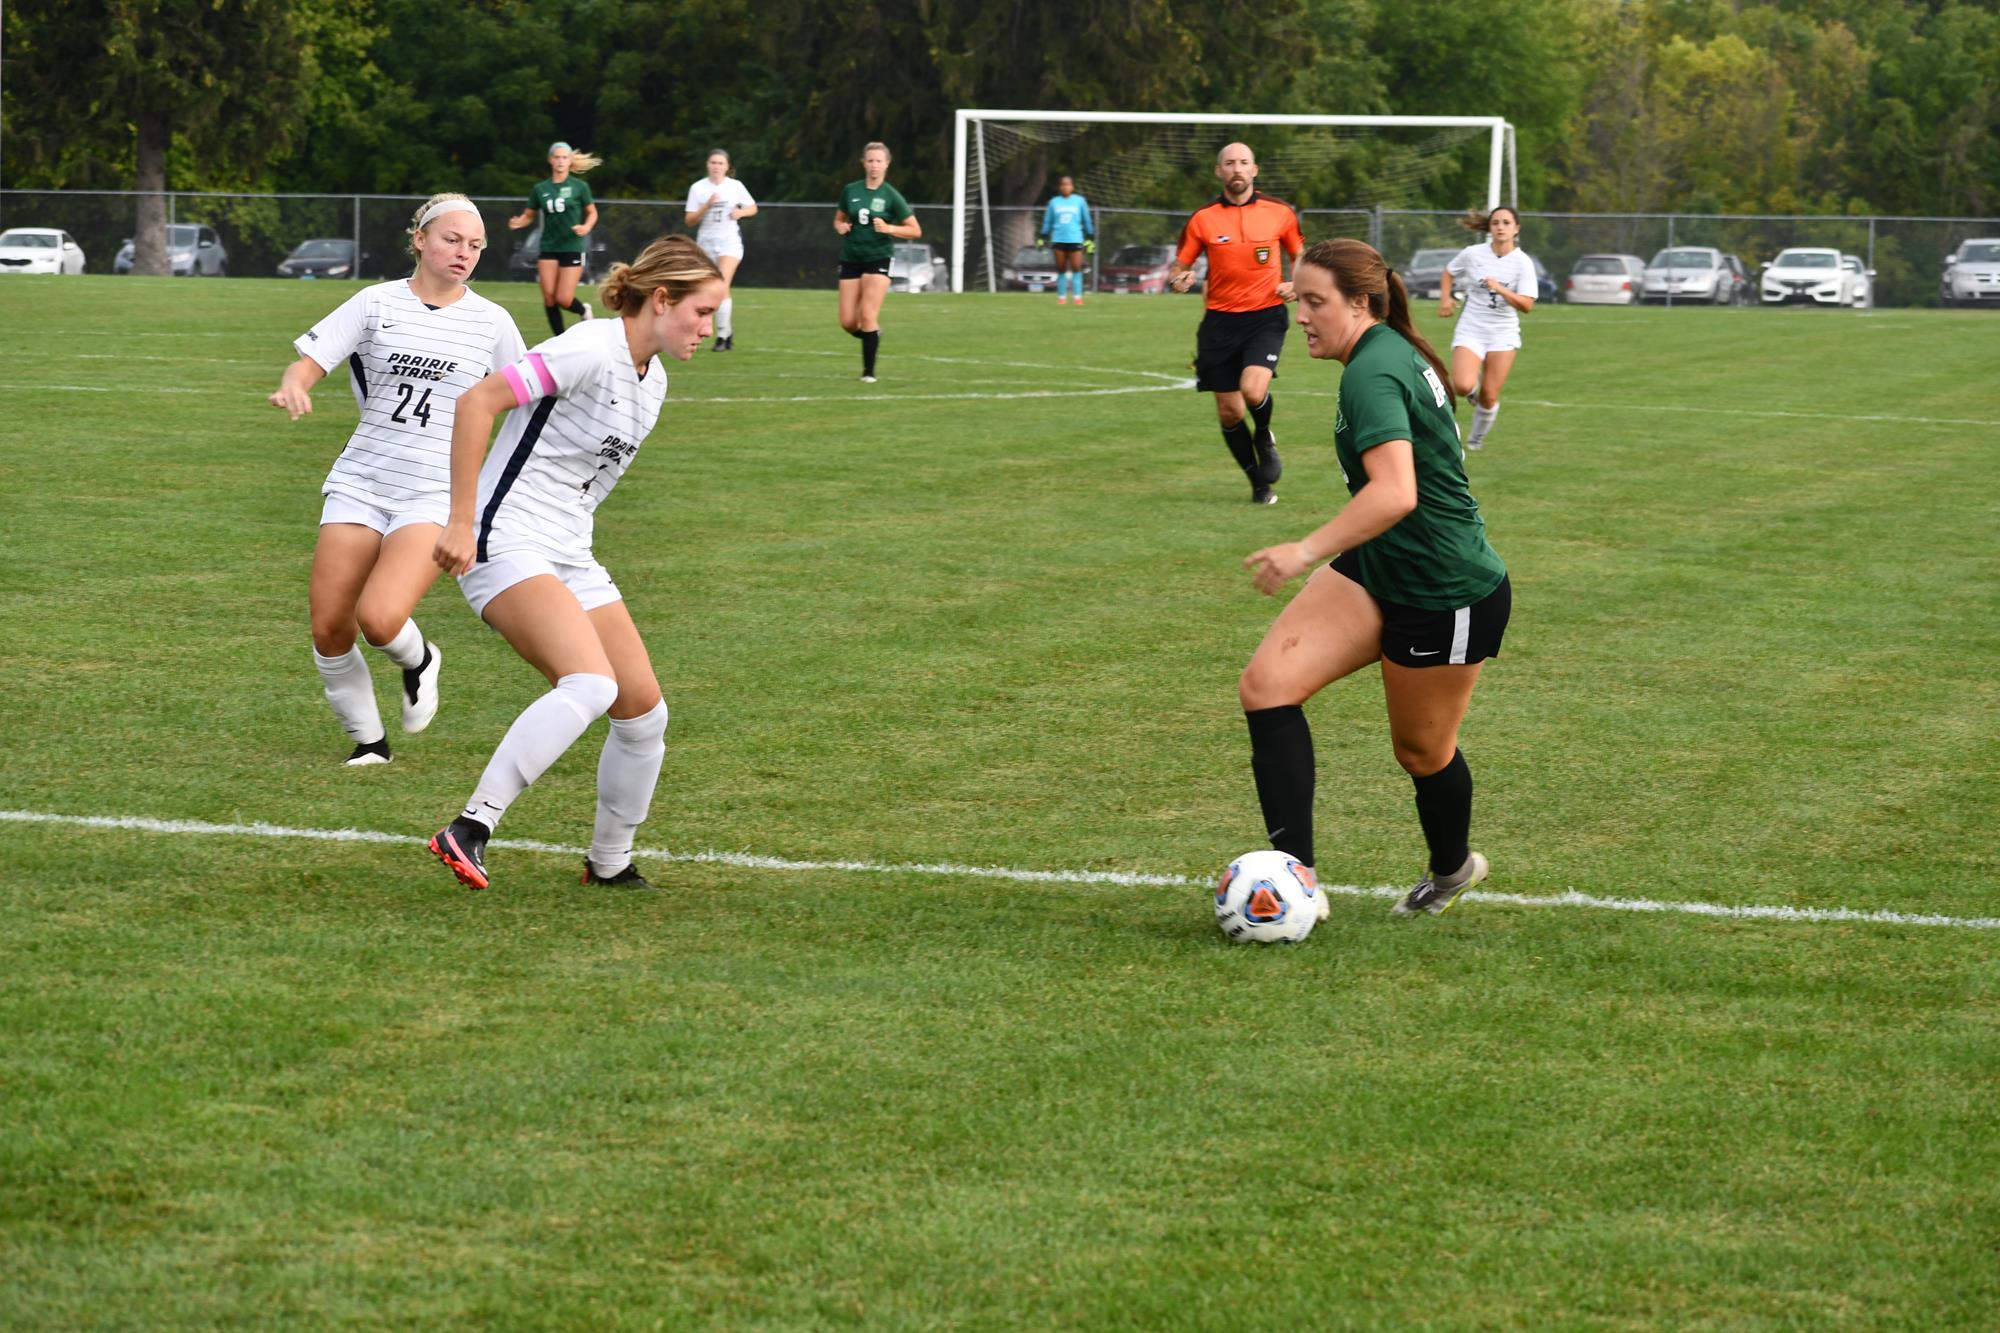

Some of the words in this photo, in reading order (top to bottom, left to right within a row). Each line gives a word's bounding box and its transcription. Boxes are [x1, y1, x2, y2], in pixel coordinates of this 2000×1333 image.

[546, 198, 566, 213] 16
[858, 208, 870, 225] 6
[387, 352, 458, 373] PRAIRIE
[389, 364, 450, 381] STARS
[391, 382, 433, 428] 24
